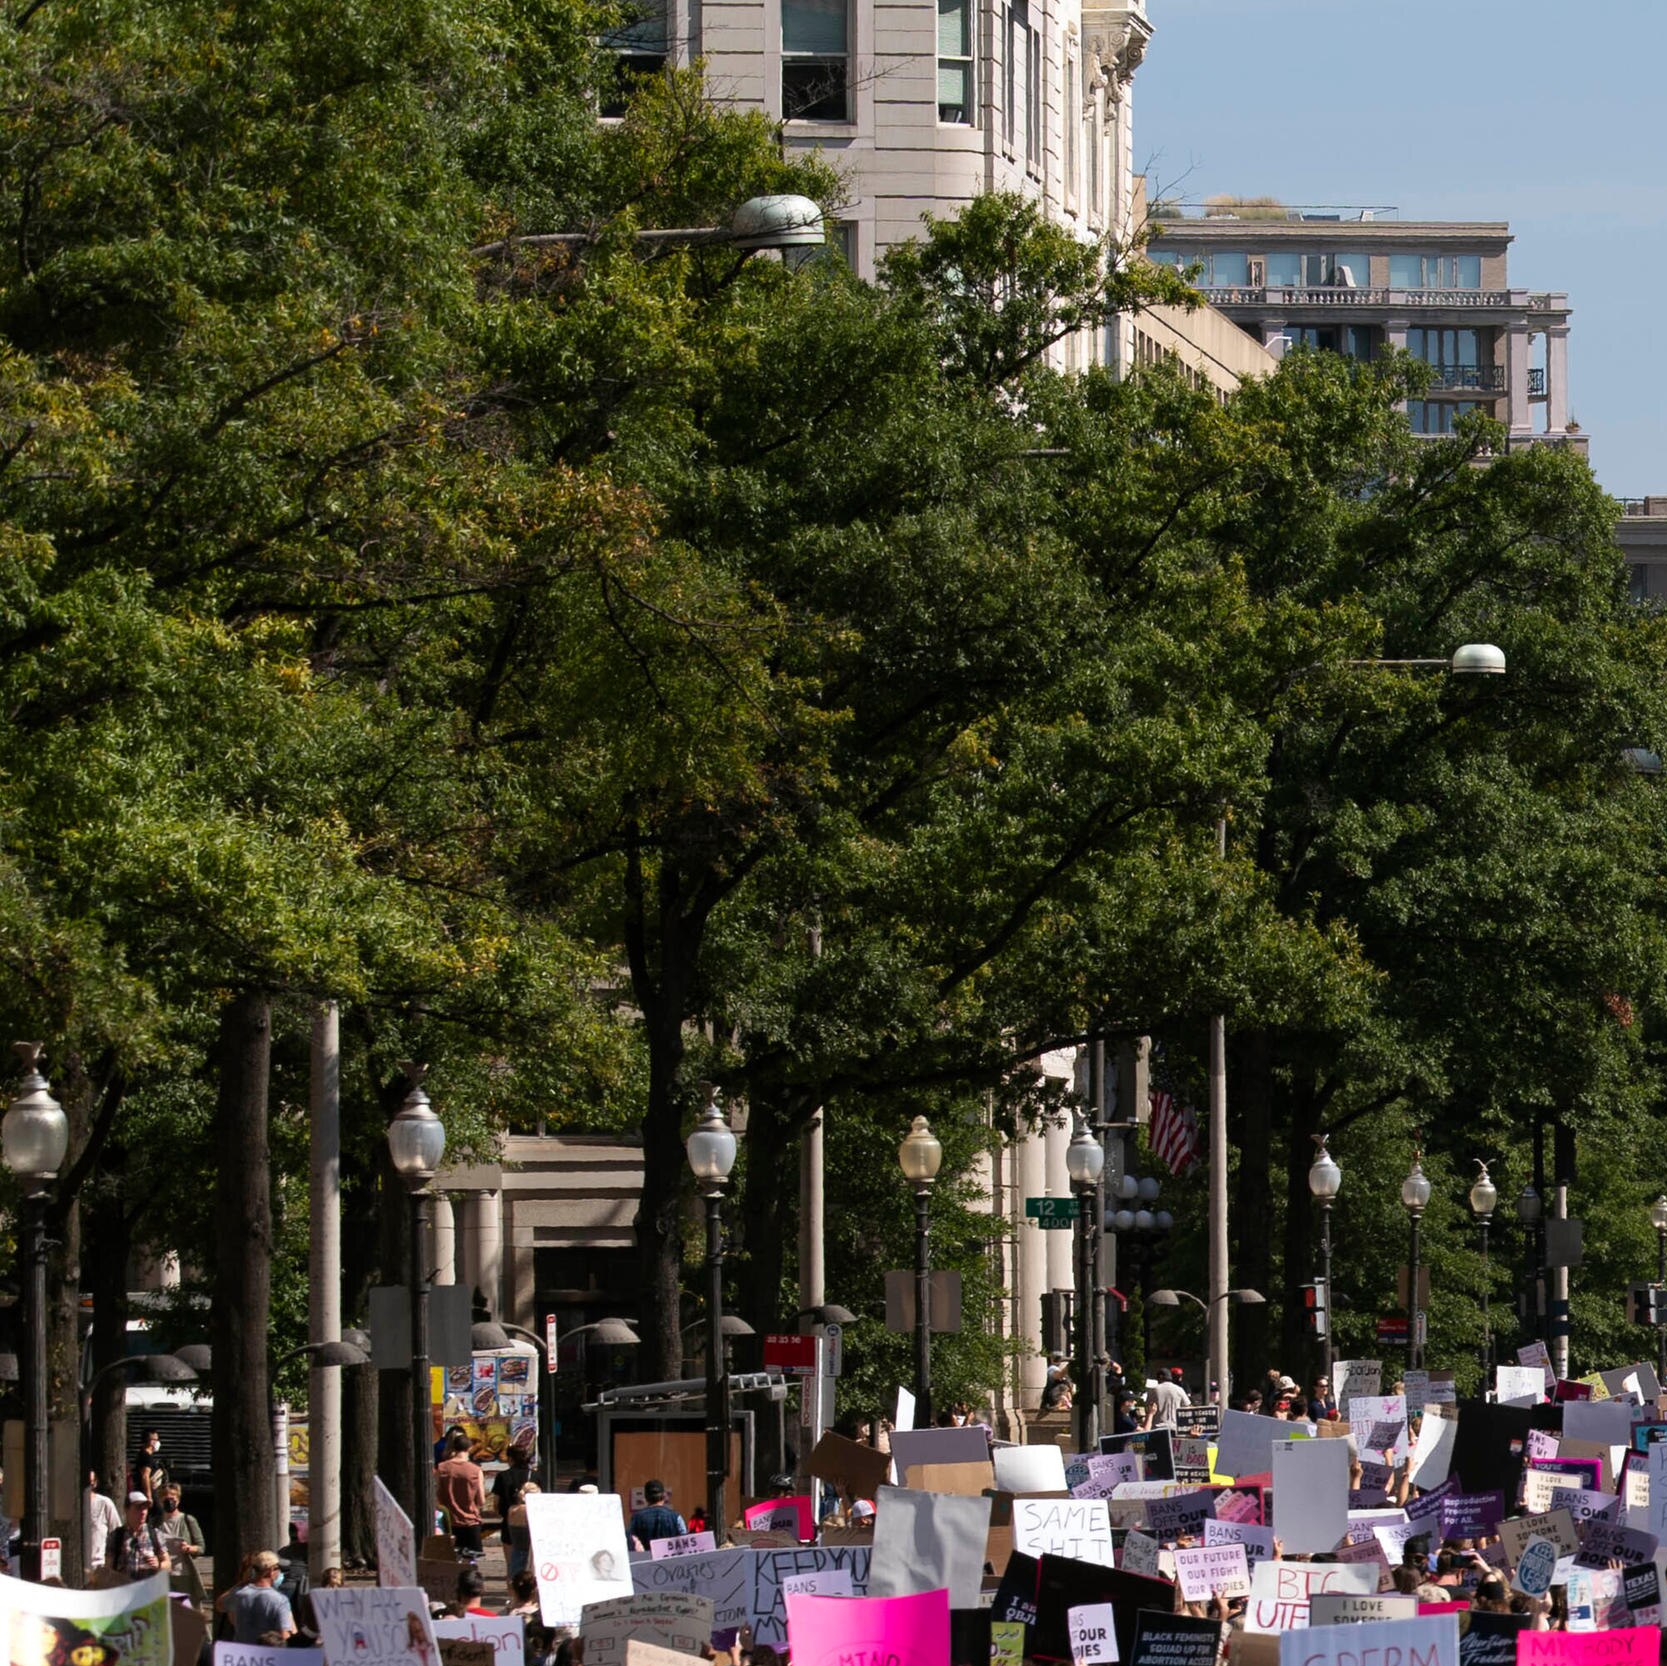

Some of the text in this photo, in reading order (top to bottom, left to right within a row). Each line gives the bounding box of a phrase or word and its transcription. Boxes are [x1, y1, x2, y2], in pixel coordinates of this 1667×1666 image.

[1025, 1503, 1107, 1532] SAME
[1179, 1550, 1242, 1565] OUR FUTURE
[1187, 1566, 1239, 1579] OUR FIGHT
[1142, 1631, 1216, 1642] BLACK FEMINISTS
[1138, 1655, 1186, 1665] ABORTION
